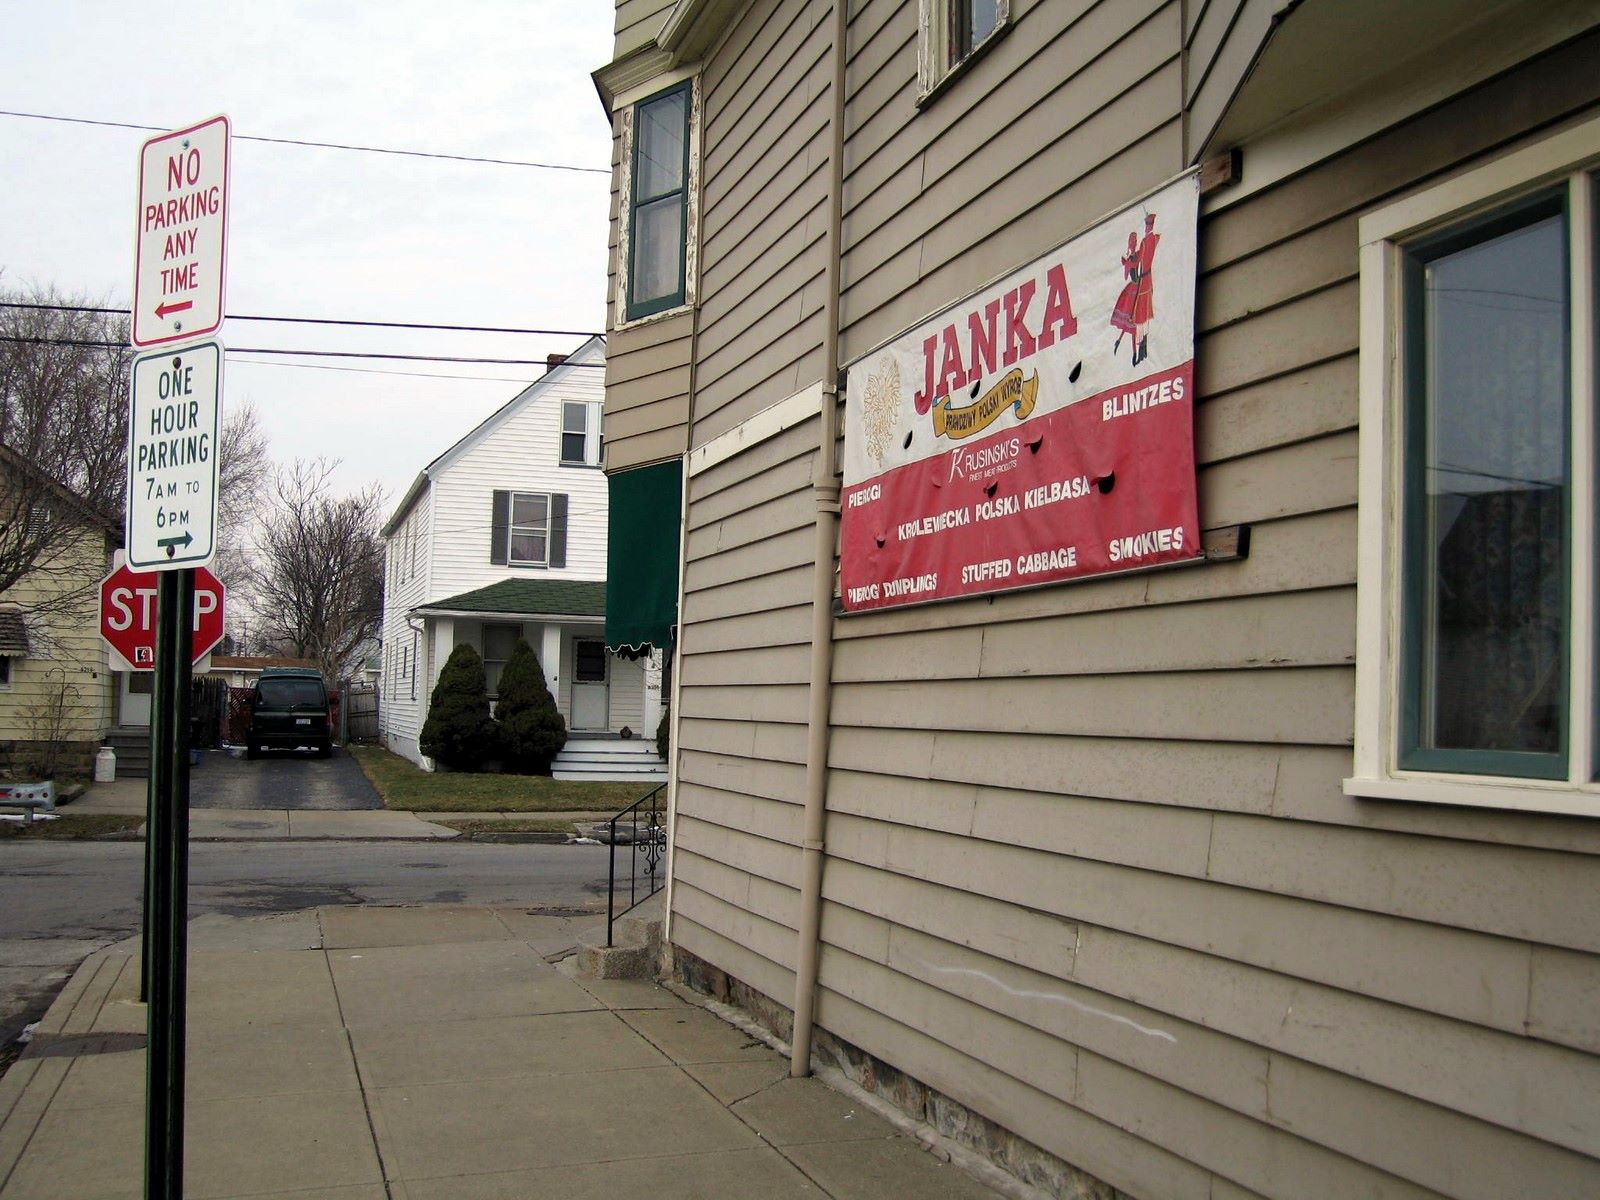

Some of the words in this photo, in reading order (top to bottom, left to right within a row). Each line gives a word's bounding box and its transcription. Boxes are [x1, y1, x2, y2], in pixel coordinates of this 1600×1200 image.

[168, 148, 201, 192] NO
[145, 186, 219, 232] PARKING
[163, 228, 198, 261] ANY
[160, 262, 199, 295] TIME
[914, 263, 1078, 416] JANKA
[159, 366, 193, 400] ONE
[1102, 376, 1184, 421] BLINTZES
[150, 400, 199, 436] HOUR
[138, 433, 209, 472] PARKING
[186, 481, 200, 494] TO
[848, 484, 881, 509] PIEROGI
[975, 495, 1020, 522] POLSKA
[1024, 475, 1091, 510] KIELBASA
[156, 506, 190, 529] 6PM
[1109, 526, 1184, 562] SMOKIES
[962, 558, 1012, 584] STUFFED
[1017, 546, 1077, 575] CABBAGE
[108, 587, 218, 631] STP
